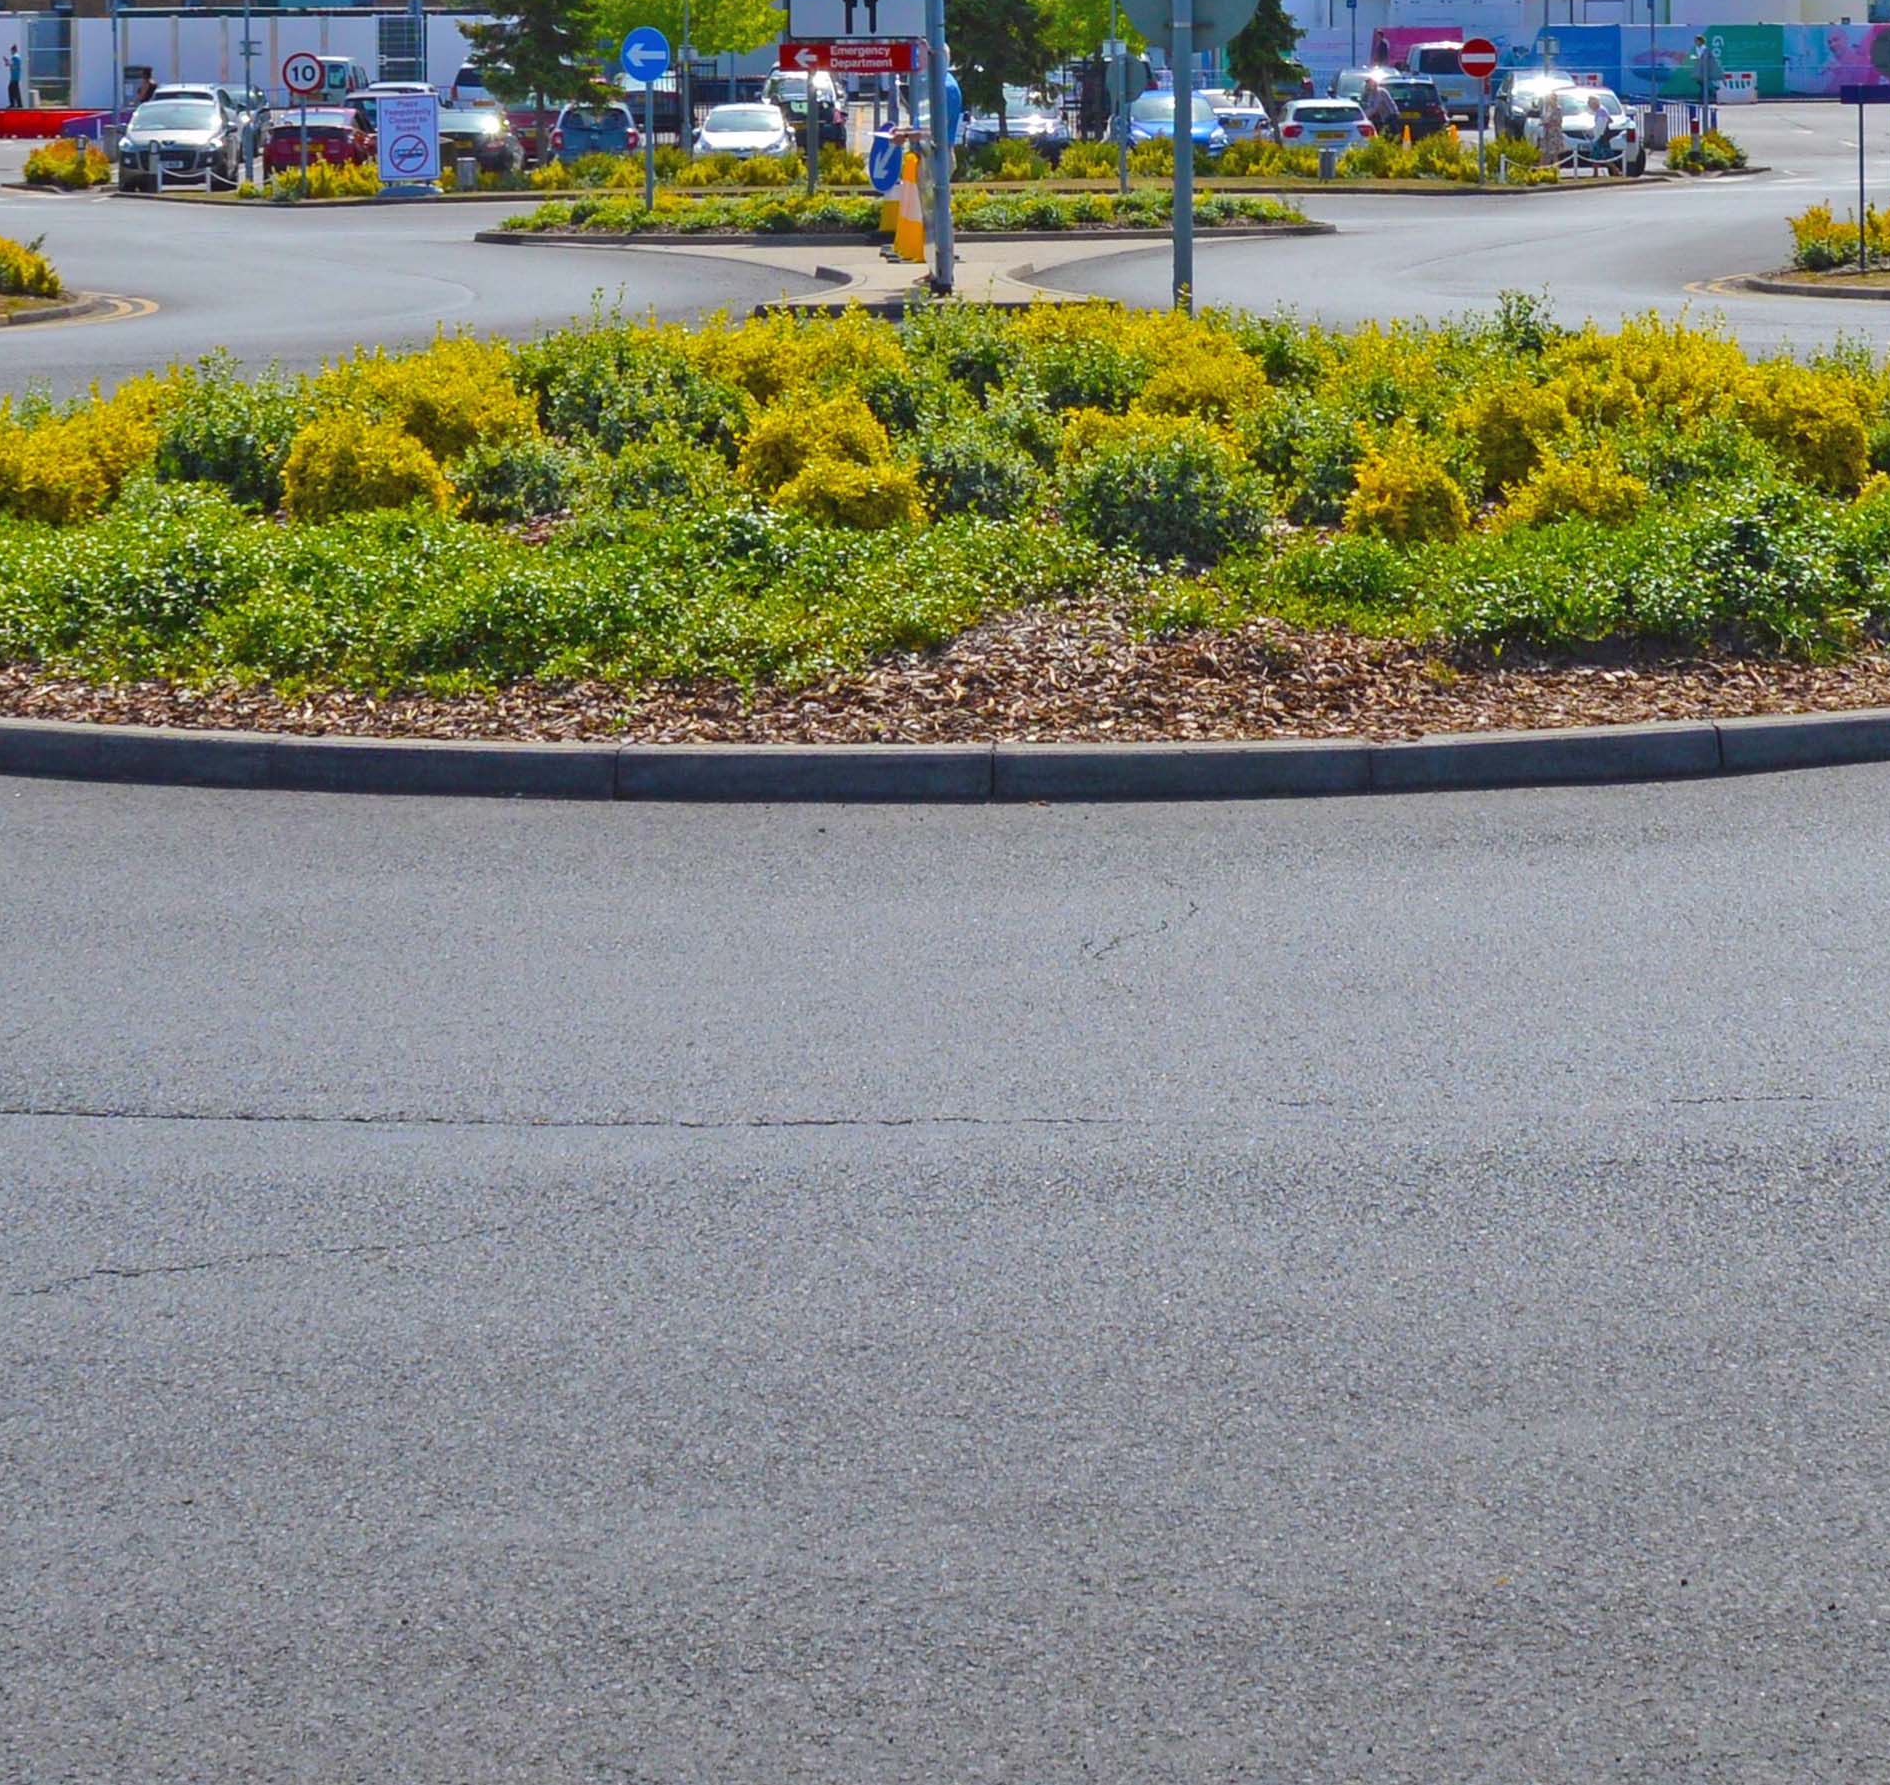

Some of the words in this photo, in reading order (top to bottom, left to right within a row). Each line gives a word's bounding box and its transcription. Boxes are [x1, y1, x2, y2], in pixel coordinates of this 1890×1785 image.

[830, 45, 891, 57] Emergency
[830, 57, 893, 69] Department
[292, 65, 316, 82] 10
